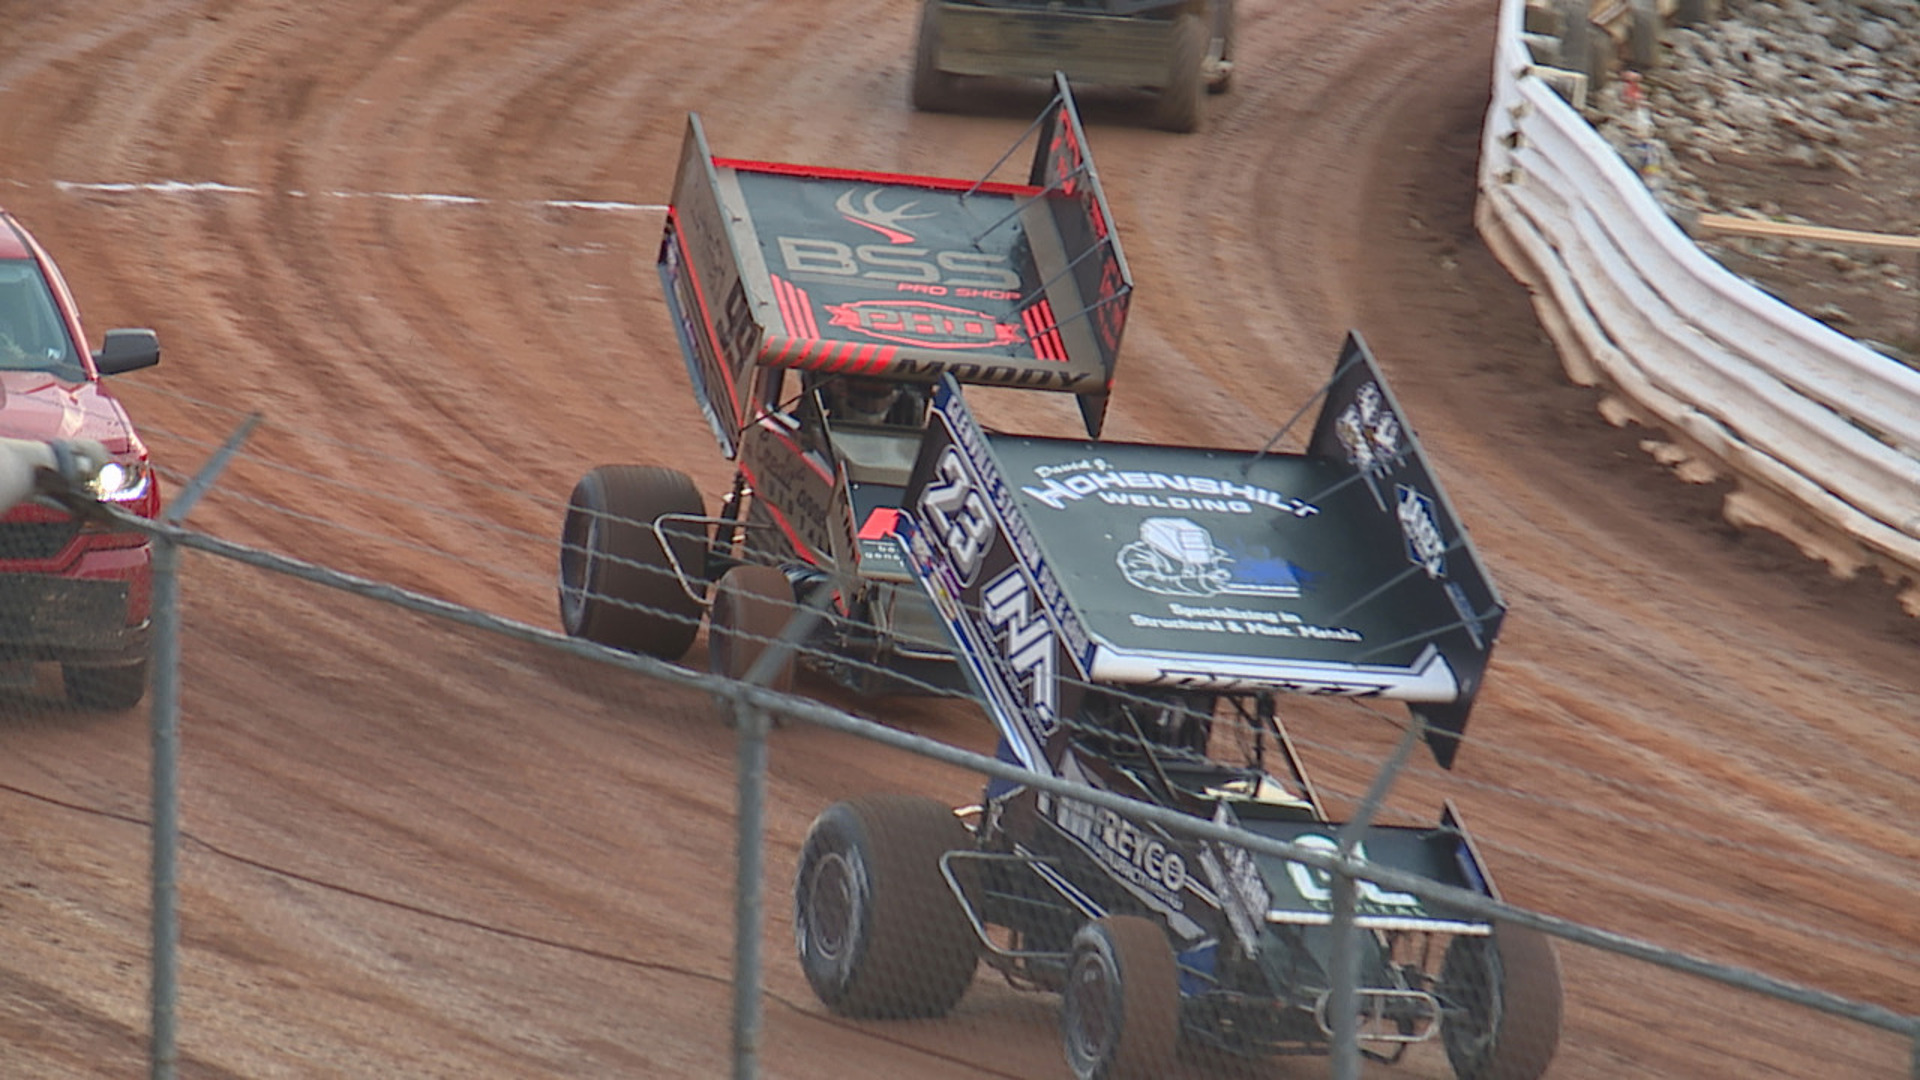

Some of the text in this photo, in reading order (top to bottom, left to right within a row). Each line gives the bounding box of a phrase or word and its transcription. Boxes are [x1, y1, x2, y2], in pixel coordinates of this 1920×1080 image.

[777, 236, 1021, 290] BSS
[897, 283, 1022, 300] PRO SHOP
[894, 357, 1092, 388] MOODY
[1034, 459, 1092, 478] David
[1098, 491, 1252, 513] WELDING
[920, 446, 995, 587] 23
[1168, 603, 1279, 624] Specializing
[1129, 613, 1225, 632] Structural
[1226, 620, 1246, 633] &
[1297, 625, 1362, 641] Metals
